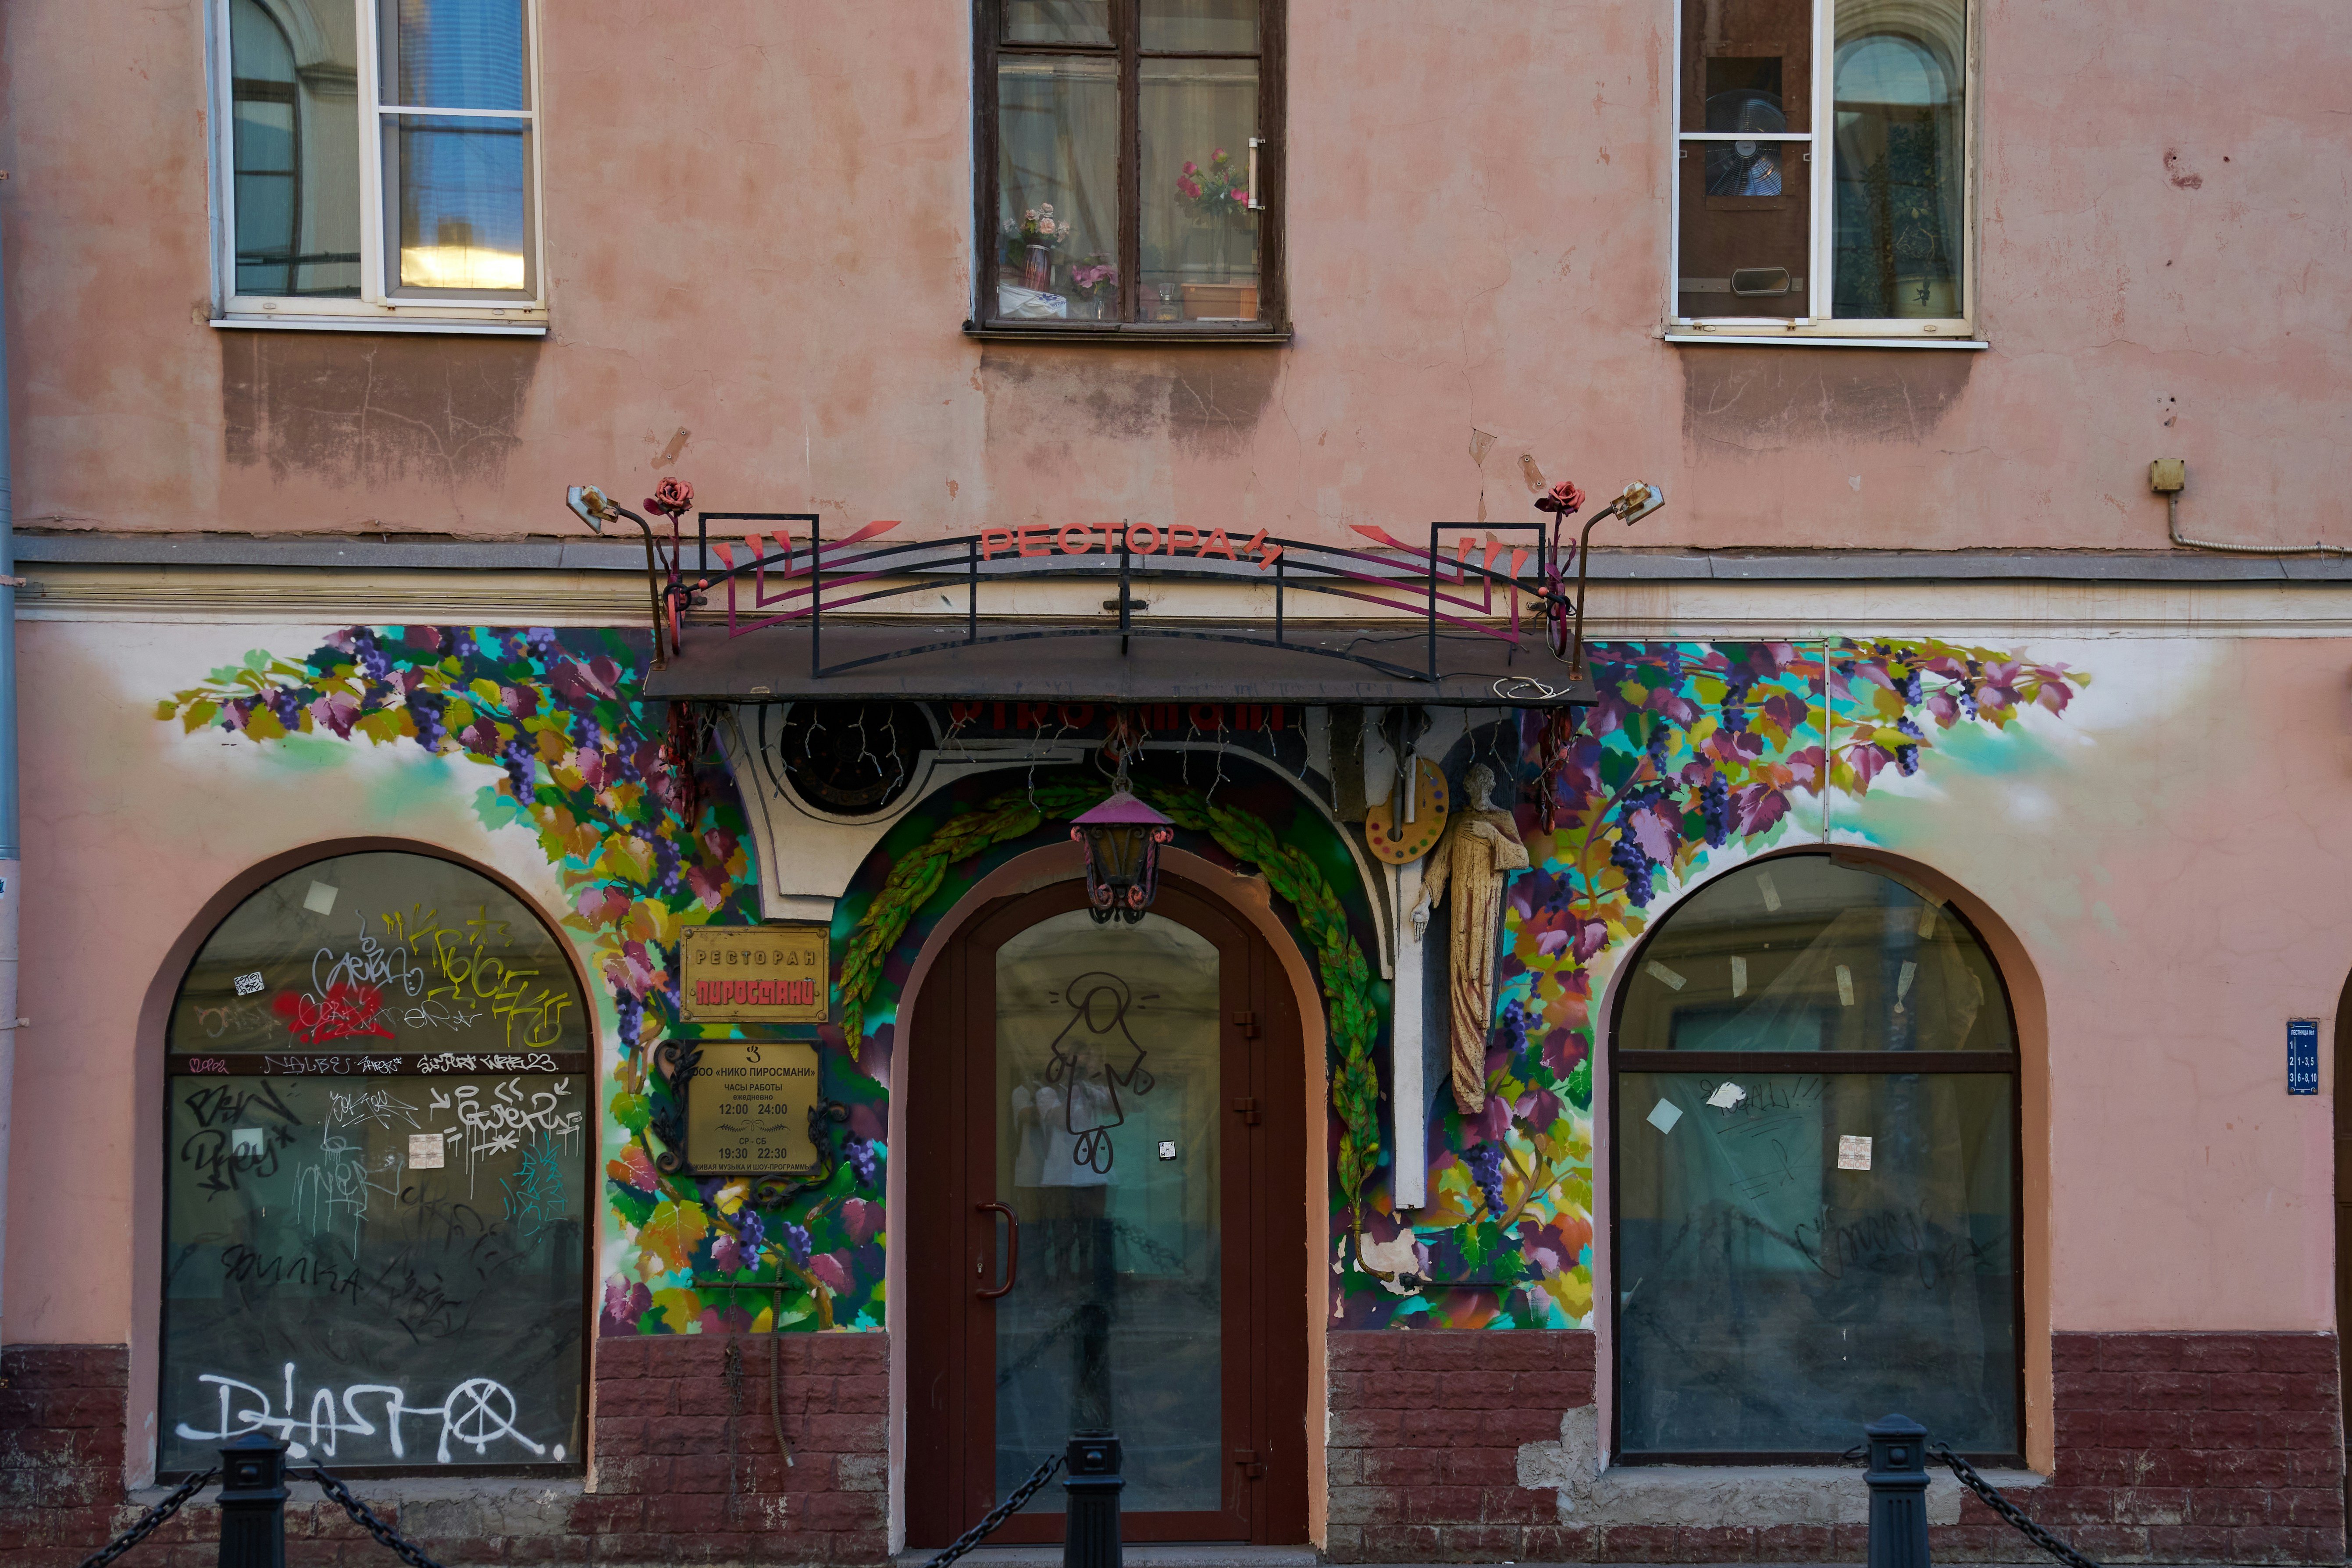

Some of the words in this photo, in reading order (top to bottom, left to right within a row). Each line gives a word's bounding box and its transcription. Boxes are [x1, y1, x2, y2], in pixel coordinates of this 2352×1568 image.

[981, 522, 1283, 571] РЕСТОРАН
[696, 949, 815, 965] РЕСТОРАН
[696, 980, 814, 1005] ПИРОСМАНИ
[2289, 1041, 2293, 1049] 1
[2289, 1056, 2294, 1066] 2
[693, 1067, 713, 1076] ООО
[716, 1067, 746, 1076] «НИКО
[749, 1067, 815, 1077] ПИРОСМАНИ»
[2290, 1073, 2294, 1082] 3
[2311, 1073, 2317, 1082] 10
[719, 1104, 748, 1115] 12:00
[758, 1104, 788, 1115] 24:00
[719, 1148, 748, 1159] 19:30
[757, 1148, 787, 1159] 22:30
